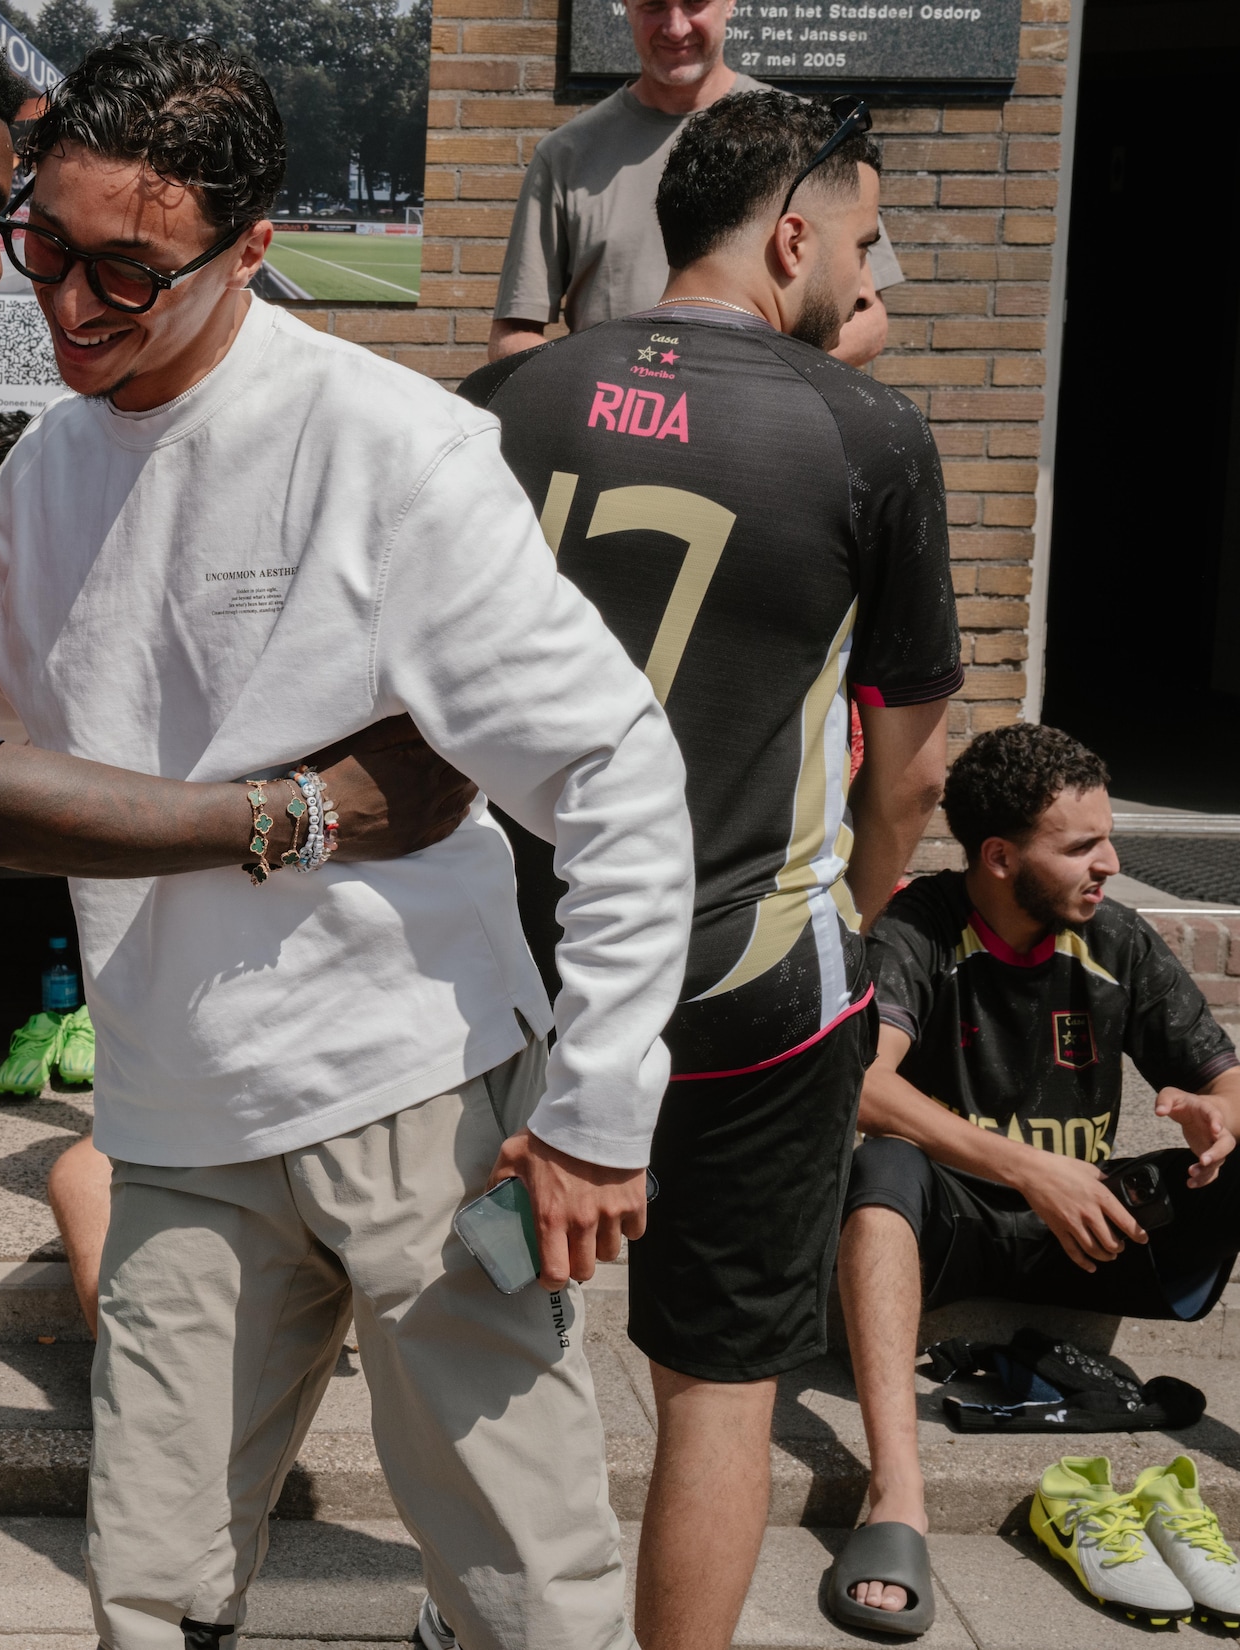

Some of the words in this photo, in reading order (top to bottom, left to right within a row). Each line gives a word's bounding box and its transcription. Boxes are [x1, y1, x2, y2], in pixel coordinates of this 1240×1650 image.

[731, 6, 752, 17] ort
[760, 7, 788, 18] van
[795, 5, 822, 18] het
[829, 4, 913, 19] Stadsdeel
[920, 5, 981, 21] Osdorp
[725, 27, 754, 40] Dhr.
[762, 28, 793, 41] Piet
[800, 27, 867, 41] Janssen
[741, 53, 760, 66] 27
[767, 53, 796, 66] mei
[803, 53, 846, 67] 2005
[650, 333, 680, 345] Casa
[630, 365, 676, 380] Maribo
[587, 381, 689, 443] RIDA
[205, 570, 256, 581] UNCOMMON
